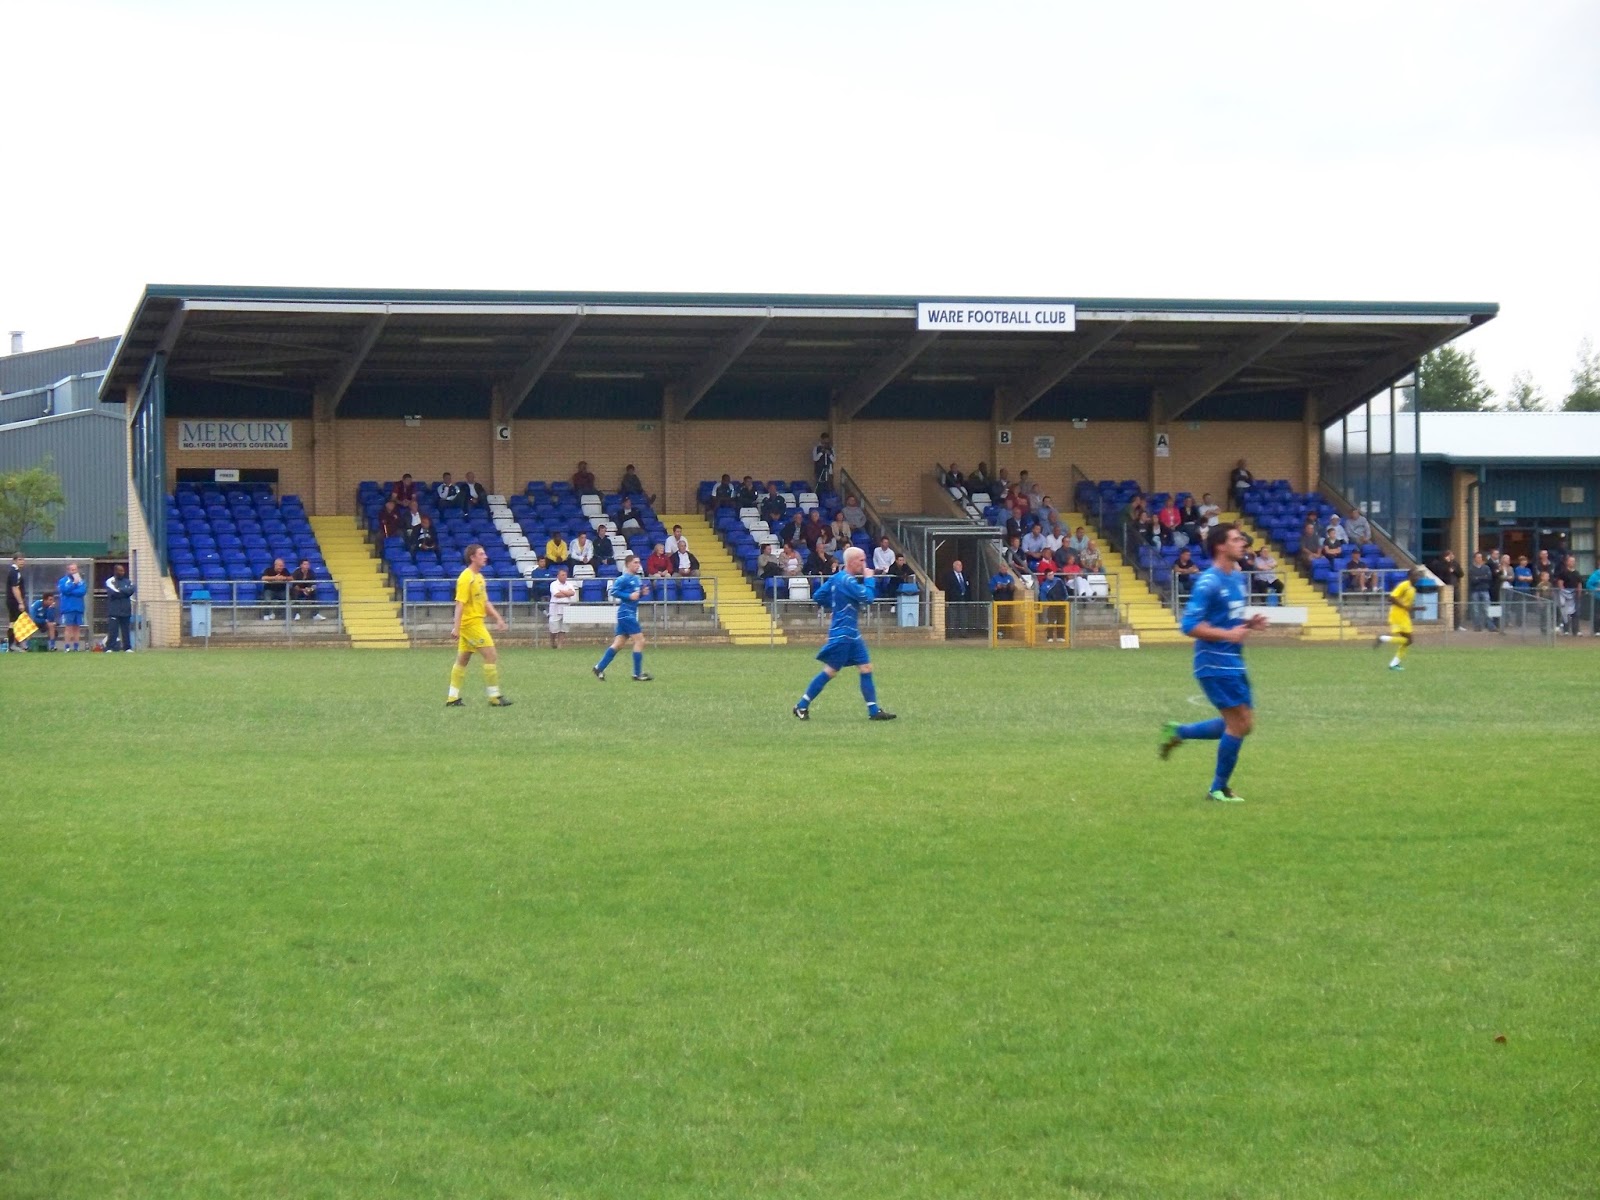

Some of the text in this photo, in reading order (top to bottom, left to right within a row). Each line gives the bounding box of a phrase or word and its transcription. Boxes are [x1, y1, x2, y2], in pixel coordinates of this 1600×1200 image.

[928, 310, 1066, 324] WARE FOOTBALL CLUB
[182, 423, 289, 442] MERCURY
[499, 427, 508, 439] C
[1000, 431, 1009, 443] B
[1157, 434, 1168, 446] A
